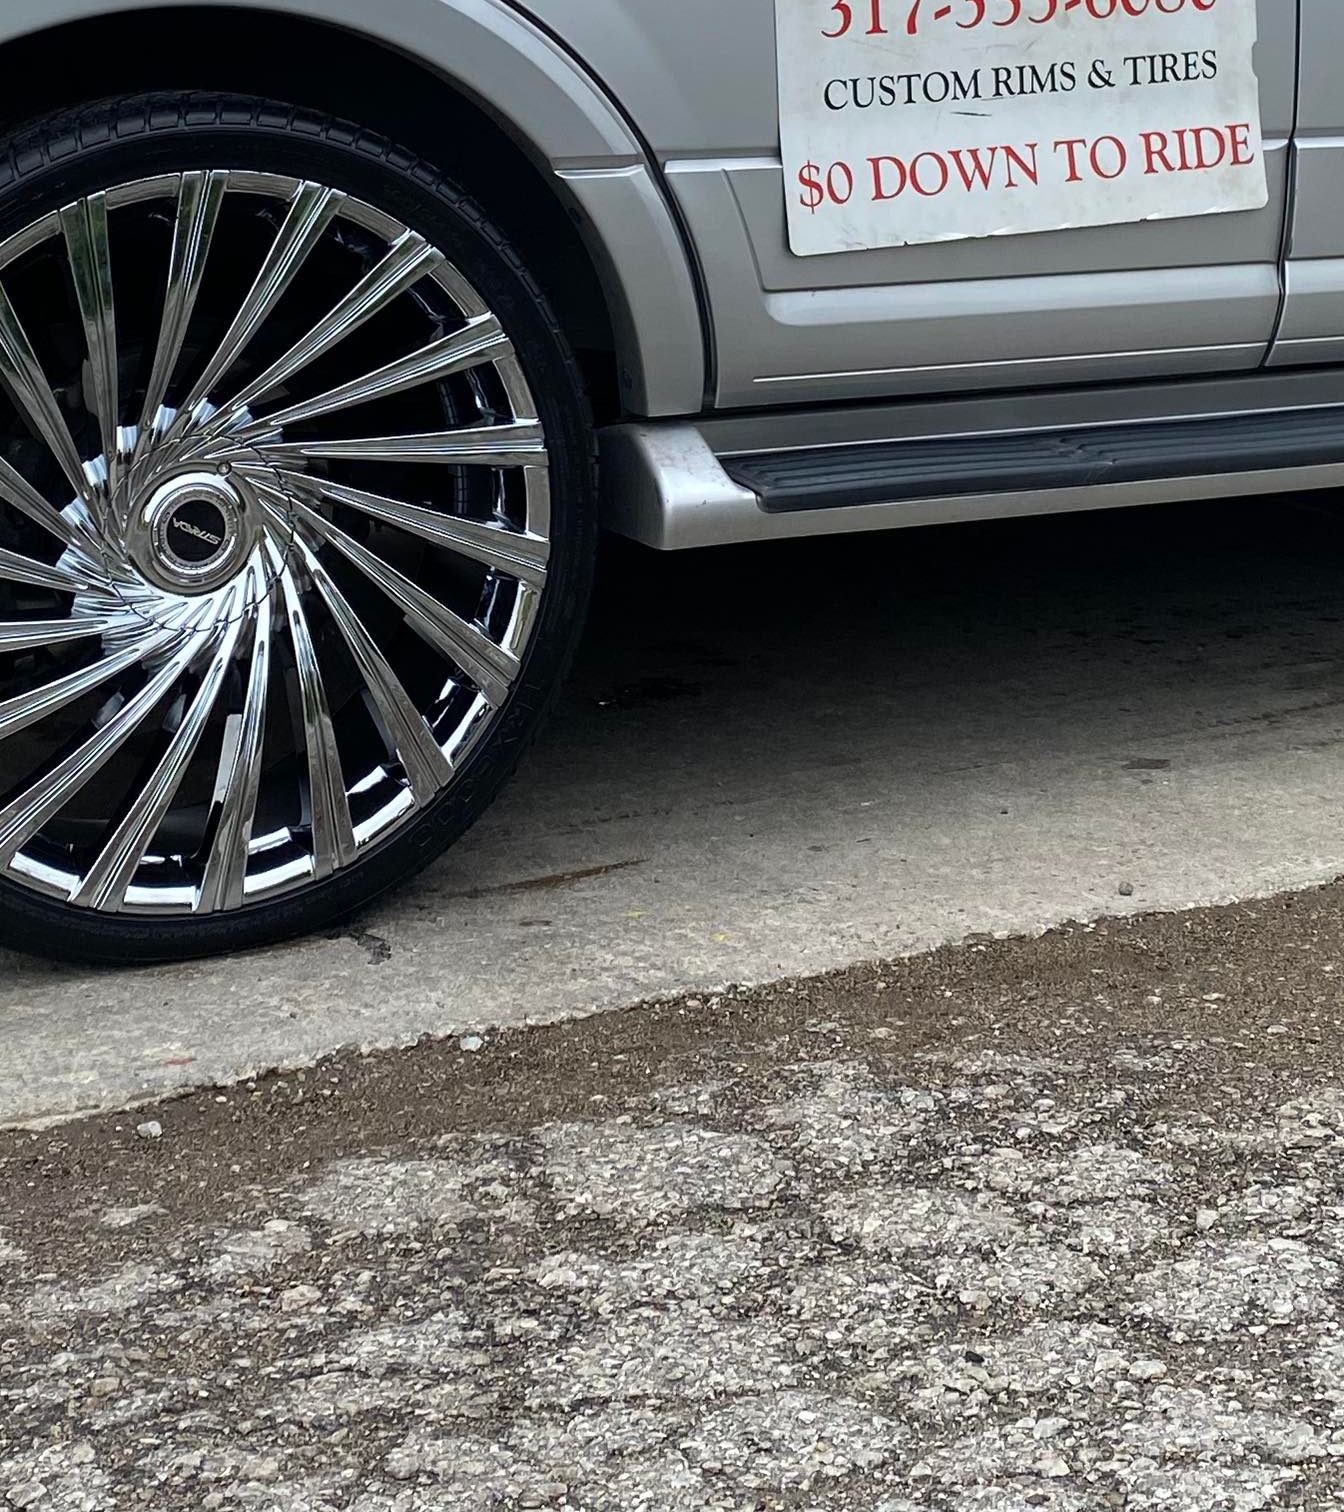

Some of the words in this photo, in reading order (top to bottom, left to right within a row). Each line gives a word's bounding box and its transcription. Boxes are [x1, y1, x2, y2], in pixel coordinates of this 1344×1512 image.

[823, 68, 981, 111] CUSTOM
[991, 62, 1077, 97] RIMS
[1088, 59, 1115, 89] &
[1123, 49, 1217, 85] TIRES
[798, 160, 853, 214] $0
[866, 143, 1039, 201] DOWN
[1053, 135, 1126, 182] TO
[1139, 123, 1255, 175] RIDE
